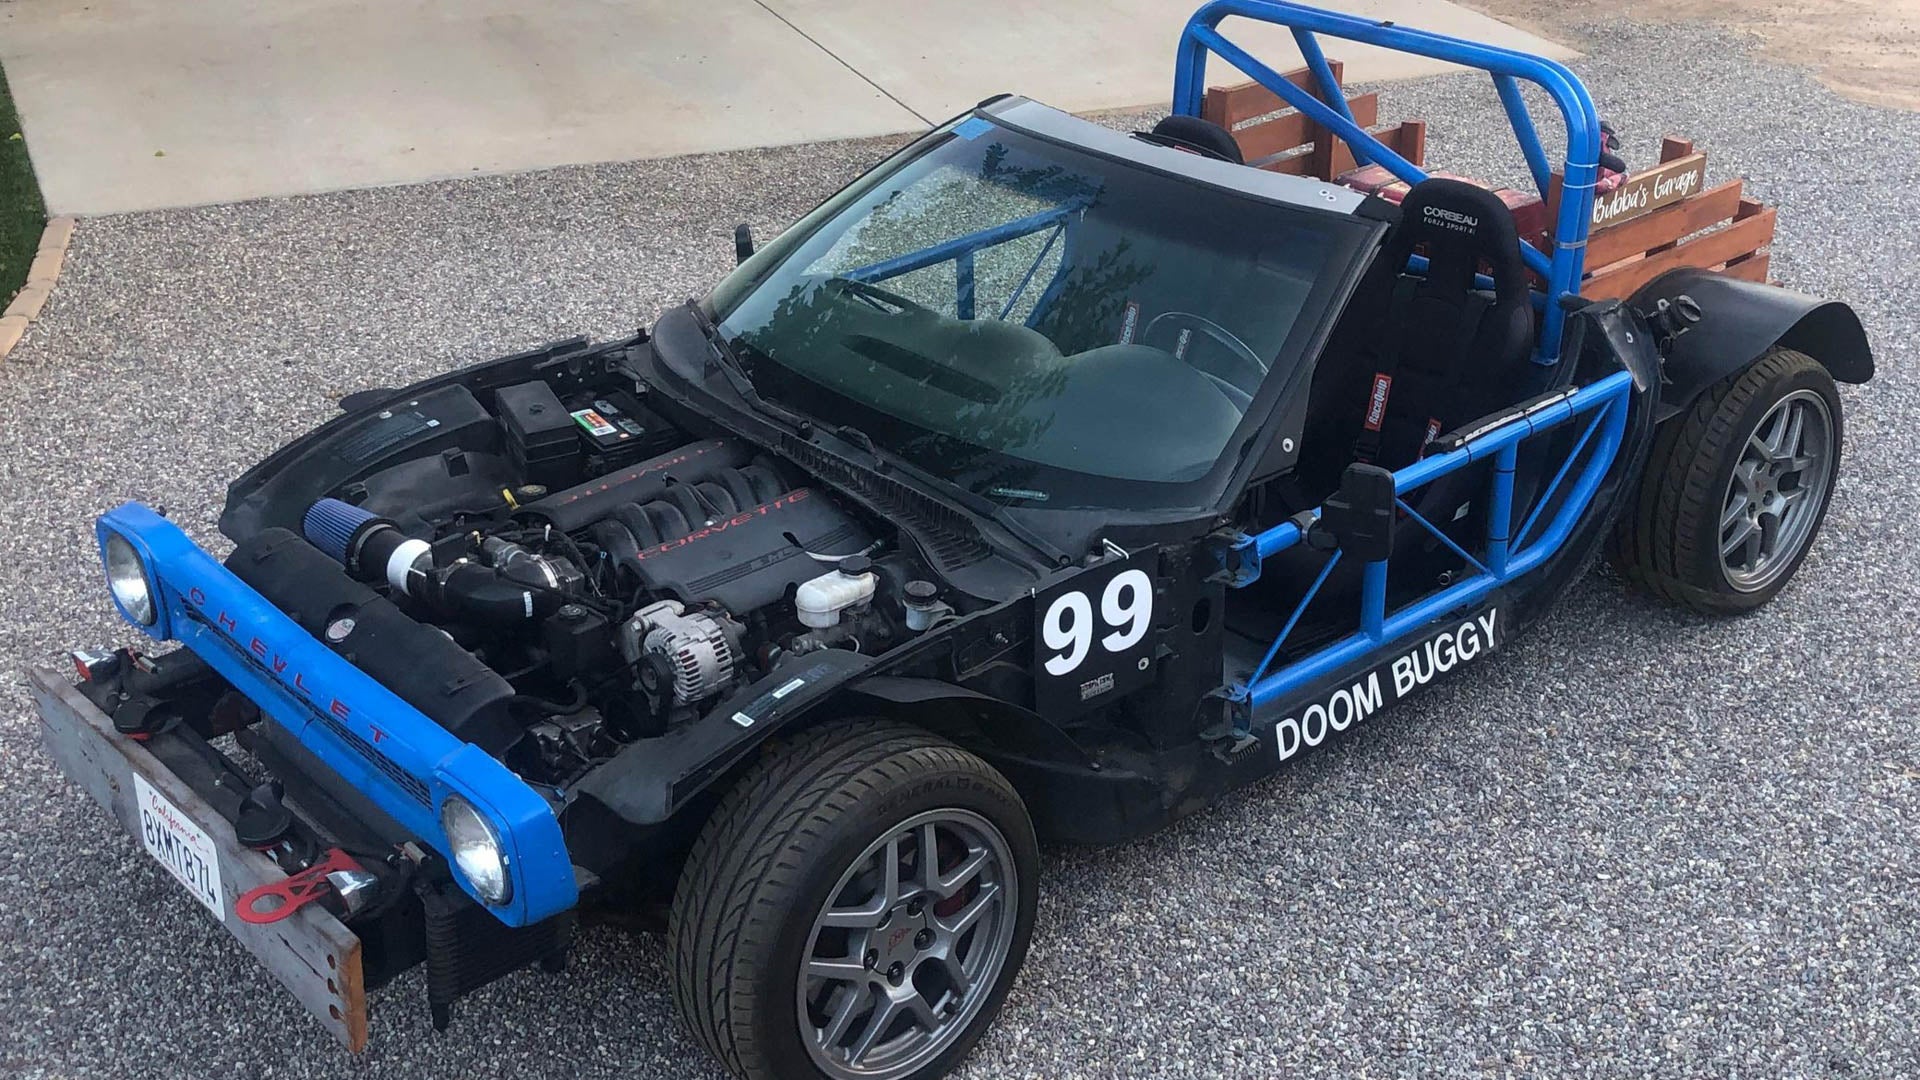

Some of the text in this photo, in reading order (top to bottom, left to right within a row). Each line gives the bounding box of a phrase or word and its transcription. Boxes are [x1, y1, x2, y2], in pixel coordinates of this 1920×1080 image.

[1423, 206, 1479, 226] CORBEAU
[1593, 169, 1698, 224] Bubba's Garage
[1368, 378, 1388, 425] RaceQuip
[637, 488, 811, 560] CORVETTE
[1043, 569, 1153, 676] 99
[189, 587, 389, 743] CHEVLET
[1275, 608, 1497, 762] DOOM BUGGY
[151, 794, 197, 843] California
[143, 809, 217, 905] 8XMT874
